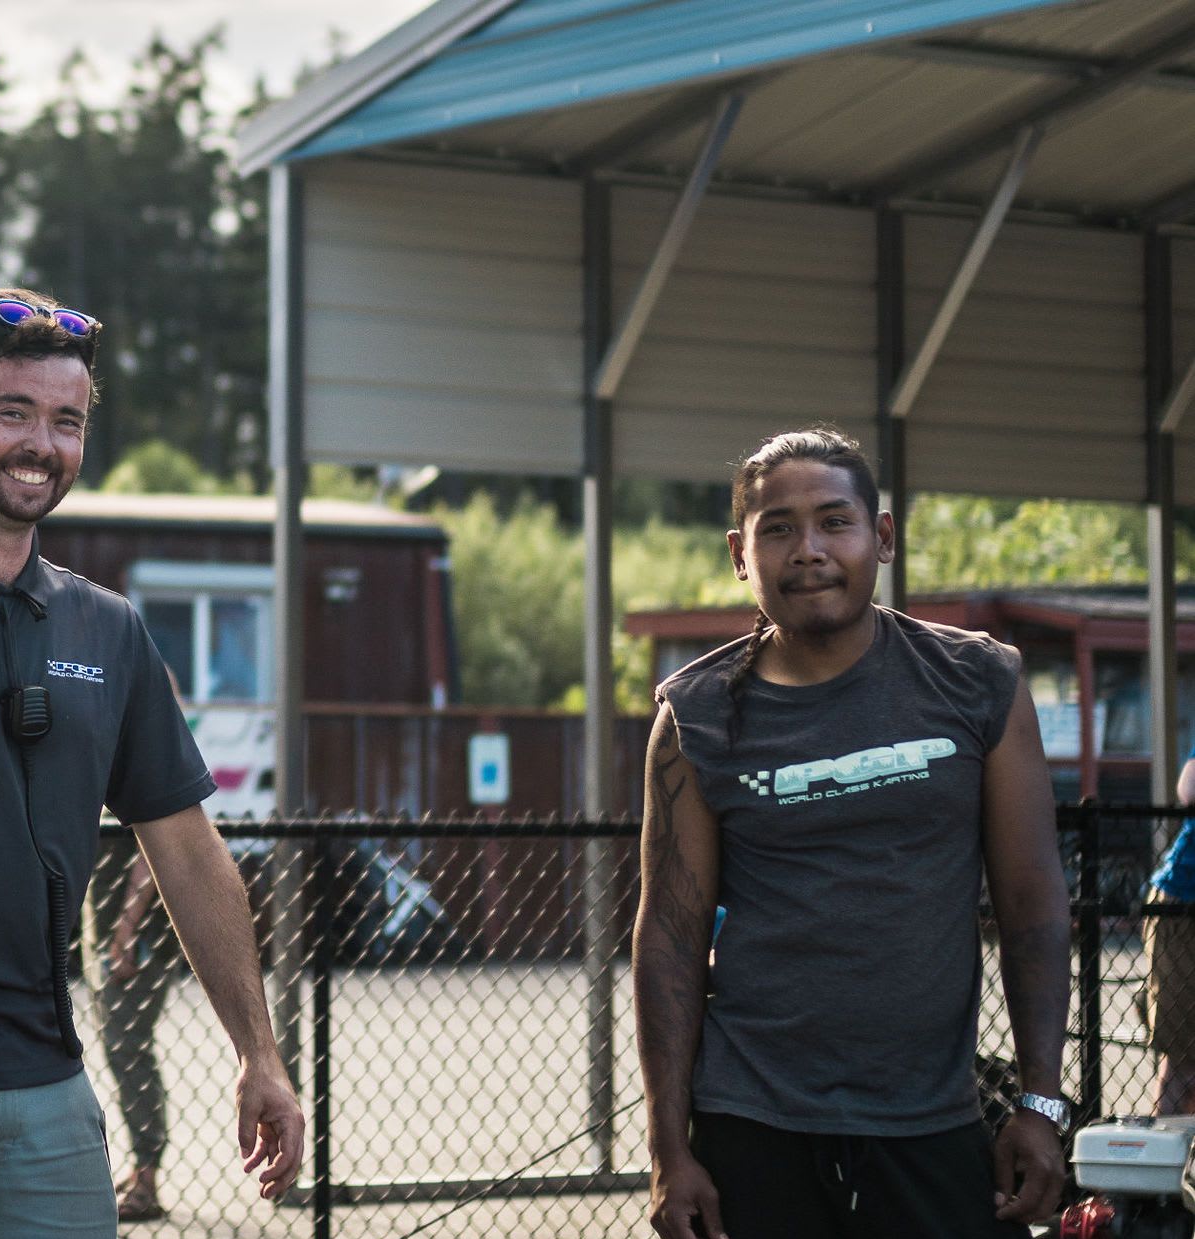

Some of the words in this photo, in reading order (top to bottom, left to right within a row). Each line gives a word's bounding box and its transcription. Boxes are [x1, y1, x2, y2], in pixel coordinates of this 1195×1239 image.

[47, 669, 65, 678] WORLD
[66, 672, 84, 680] CLASS
[778, 791, 823, 806] WORLD
[825, 782, 870, 799] CLASS
[872, 770, 930, 788] KARTING
